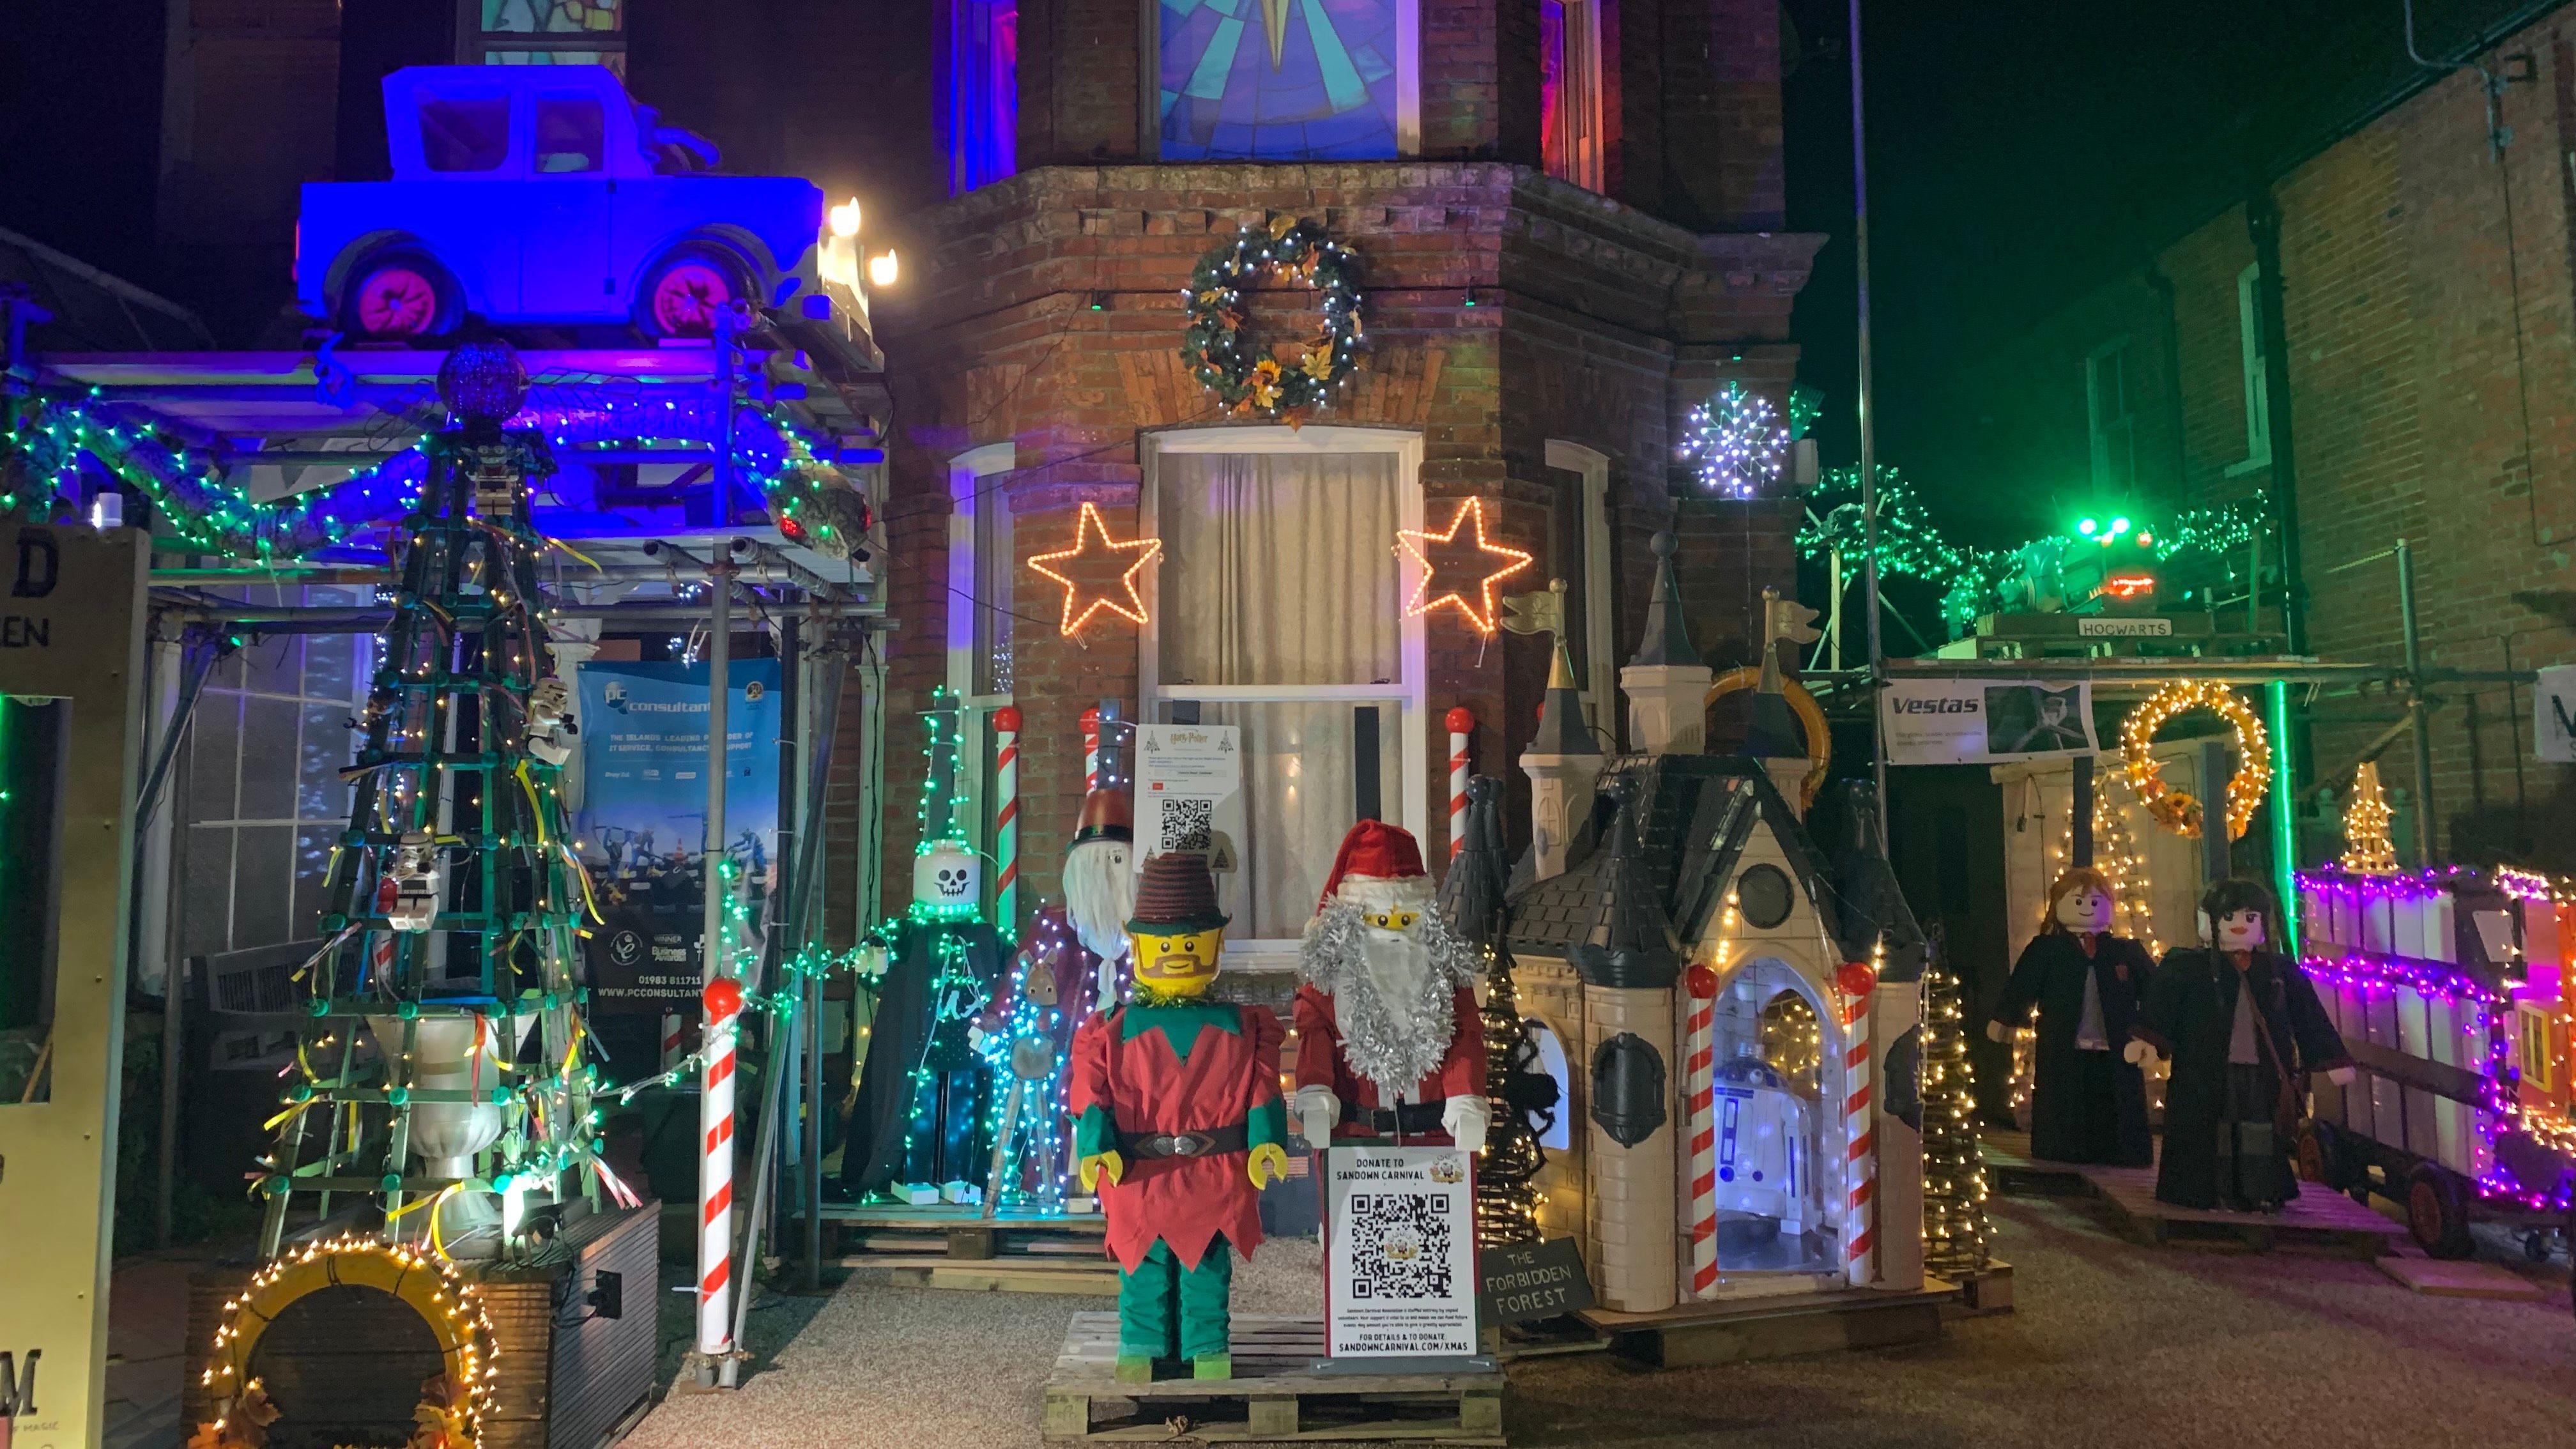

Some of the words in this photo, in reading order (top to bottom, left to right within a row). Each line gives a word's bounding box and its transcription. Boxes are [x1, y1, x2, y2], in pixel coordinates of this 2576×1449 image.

[11, 526, 59, 597] D
[1892, 697, 1979, 714] Vestas
[726, 742, 753, 751] UPPORT
[639, 976, 667, 985] 01983
[670, 976, 702, 985] 811711
[1356, 1159, 1391, 1168] DONATE
[1394, 1158, 1404, 1167] TO
[1337, 1171, 1379, 1180] SANDOWN
[1382, 1170, 1424, 1179] CARNIVAL
[1507, 1251, 1535, 1266] THE
[1485, 1265, 1572, 1293] FORBIDDEN
[1496, 1287, 1565, 1315] FOREST
[1339, 1342, 1468, 1353] SANDOWNCARNIVAL.COM/XMAS
[23, 1420, 60, 1432] MAGIC
